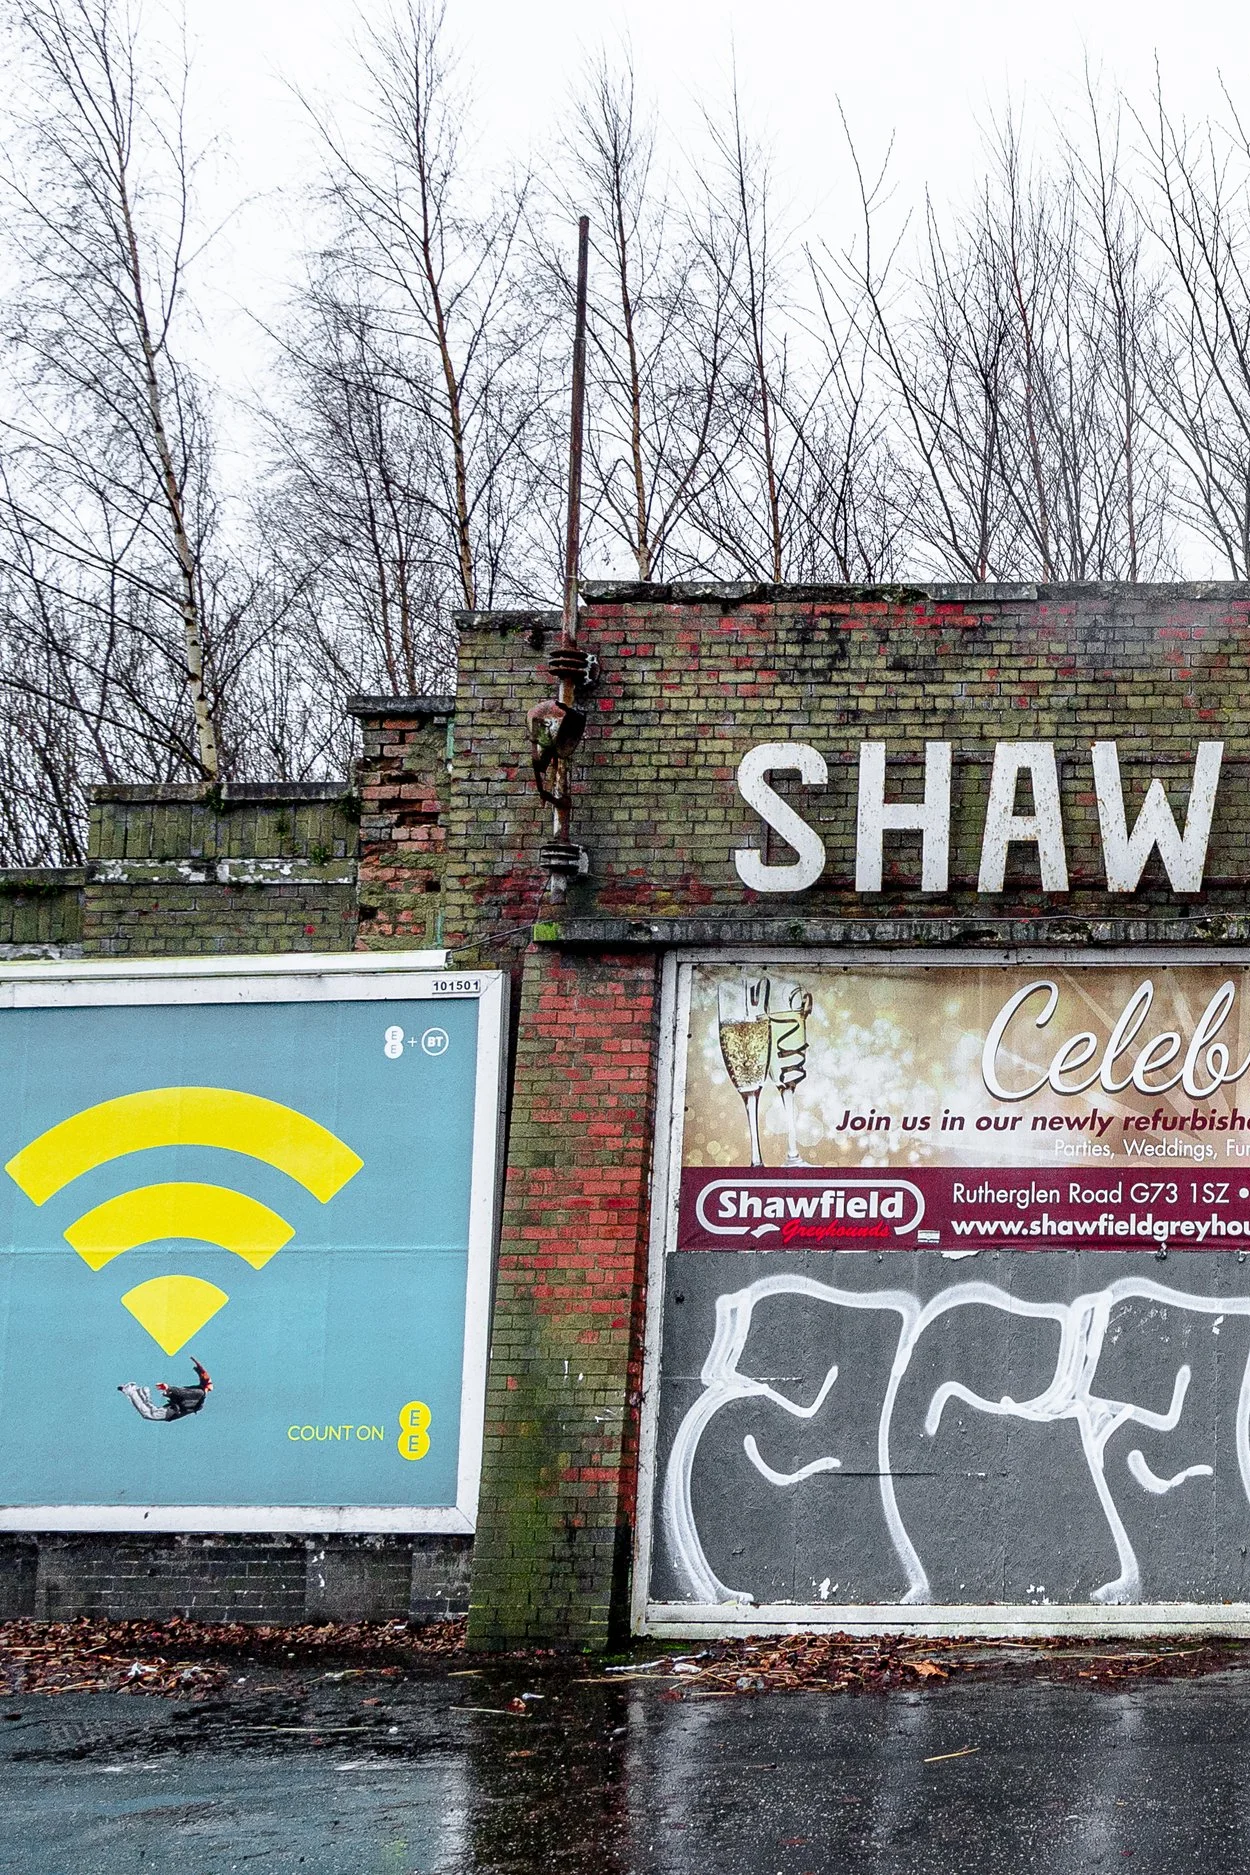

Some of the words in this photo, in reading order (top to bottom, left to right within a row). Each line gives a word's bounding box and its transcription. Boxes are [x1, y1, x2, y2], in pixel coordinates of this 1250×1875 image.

[433, 980, 479, 991] 101501
[427, 1036, 443, 1047] BT
[835, 1108, 891, 1132] Join
[901, 1114, 931, 1131] us
[940, 1108, 965, 1131] in
[975, 1114, 1022, 1131] our
[1031, 1108, 1114, 1137] newly
[1054, 1139, 1115, 1159] Parties,
[1123, 1138, 1218, 1161] Weddings,
[718, 1190, 904, 1219] Shawfield
[953, 1181, 1060, 1209] Rutherglen
[1070, 1181, 1122, 1204] Road
[1130, 1183, 1178, 1204] G73
[1190, 1183, 1230, 1203] 1SZ
[781, 1218, 891, 1244] Greyhounds
[287, 1425, 353, 1441] COUNT
[356, 1425, 384, 1441] ON
